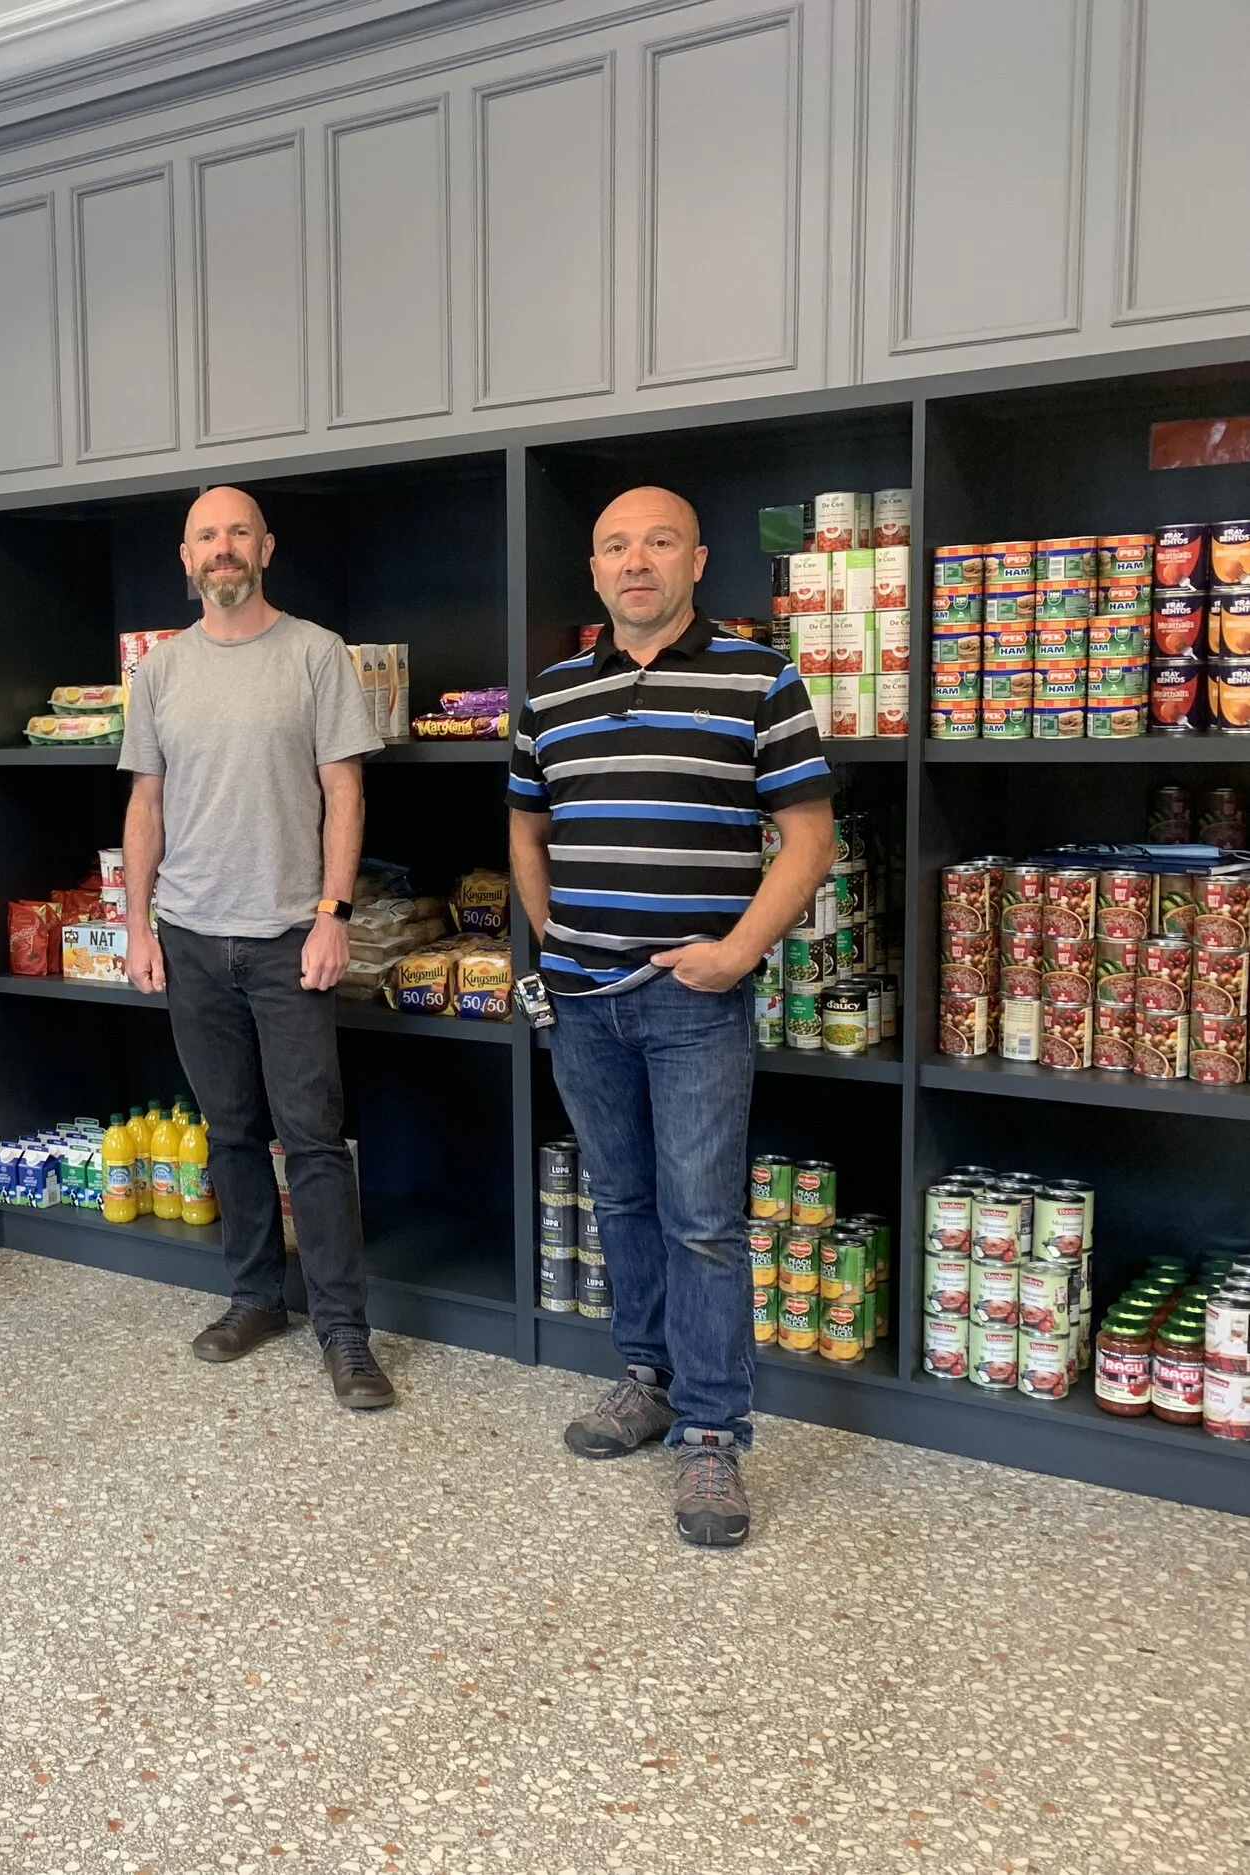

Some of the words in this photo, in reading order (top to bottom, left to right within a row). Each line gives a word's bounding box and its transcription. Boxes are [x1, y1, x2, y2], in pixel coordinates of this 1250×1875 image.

[1164, 532, 1183, 540] FRAY
[1219, 535, 1250, 543] BENTOS
[1160, 537, 1189, 546] BENTOS
[1118, 548, 1142, 557] PEK
[1006, 554, 1028, 564] PEK
[1117, 562, 1143, 570] HAM
[1005, 568, 1030, 576] HAM
[1110, 590, 1133, 598] PEK
[1109, 602, 1135, 610] HAM
[1161, 607, 1192, 615] BENTOS
[1002, 634, 1024, 642] PEK
[1041, 633, 1062, 641] PEK
[1000, 647, 1026, 655] HAM
[1040, 646, 1065, 654] HAM
[937, 675, 957, 683] PEK
[1050, 672, 1072, 680] PEK
[1156, 676, 1186, 684] BENTOS
[936, 687, 959, 695] HAM
[1048, 685, 1075, 693] HAM
[953, 712, 974, 720] PEK
[416, 717, 473, 737] Maryland
[463, 883, 503, 904] Kingsmill
[463, 910, 501, 928] 50/50
[90, 930, 116, 947] NAT
[400, 964, 445, 984] Kingsmill
[462, 967, 510, 988] Kingsmill
[402, 990, 444, 1007] 50/50
[461, 995, 506, 1013] 50/50
[551, 1165, 570, 1174] LUPA
[797, 1190, 820, 1199] PEACH
[543, 1217, 559, 1227] LUPA
[788, 1257, 812, 1265] PEACH
[789, 1263, 812, 1271] SLICES
[586, 1277, 604, 1287] LUPA
[786, 1313, 808, 1322] PEACH
[786, 1319, 809, 1328] SLICES
[830, 1324, 854, 1332] PEACH
[831, 1329, 854, 1338] SLICES
[1104, 1358, 1144, 1374] RAGU
[1159, 1366, 1200, 1382] RAGU
